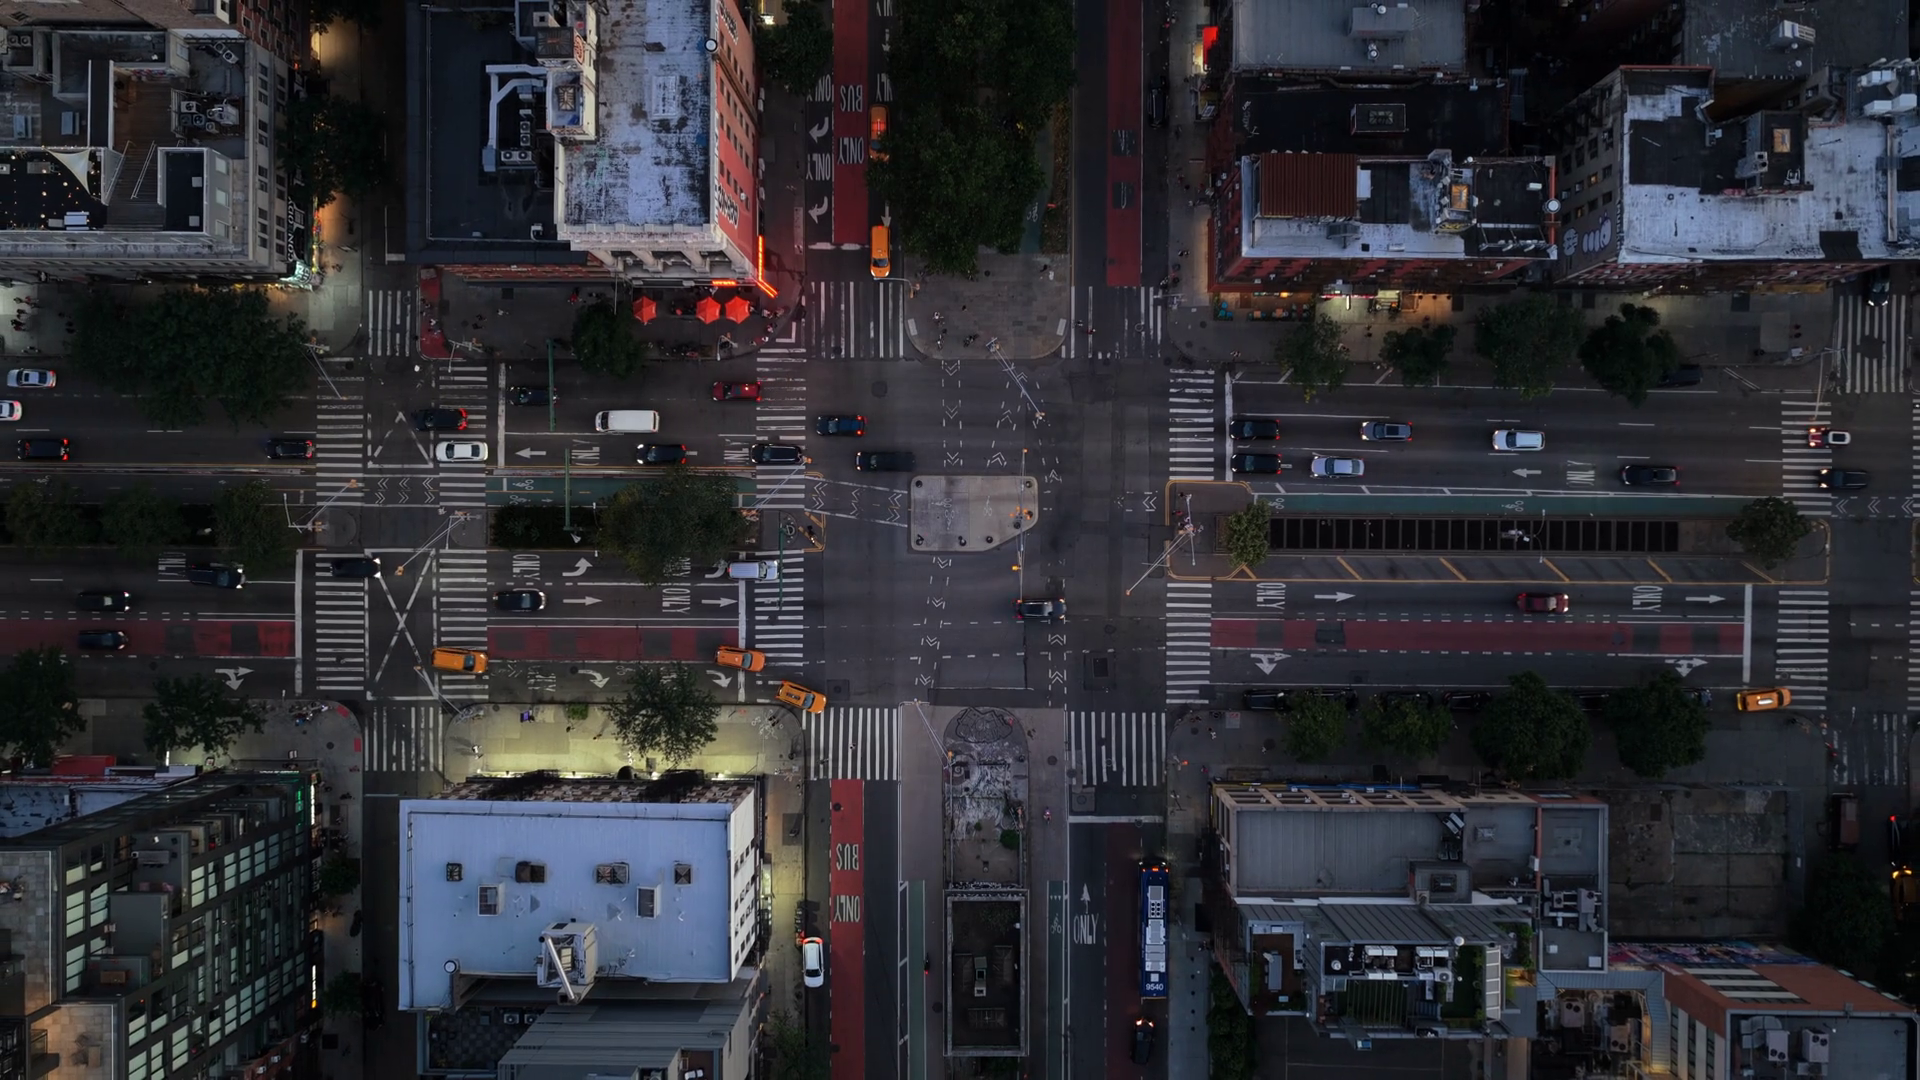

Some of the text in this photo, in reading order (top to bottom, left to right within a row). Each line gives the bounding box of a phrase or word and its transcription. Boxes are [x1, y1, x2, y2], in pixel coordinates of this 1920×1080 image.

[840, 85, 863, 112] BUS
[876, 73, 893, 102] NLY
[838, 137, 864, 164] ONLY
[806, 153, 831, 181] ONLY
[513, 554, 540, 580] ONLY
[662, 588, 690, 614] ONLY
[1256, 583, 1286, 610] ONLY
[1632, 586, 1663, 612] ONLY
[836, 843, 859, 870] BUS
[834, 895, 861, 922] ONLY
[1074, 913, 1099, 944] ONLY
[1146, 983, 1164, 991] 9540
